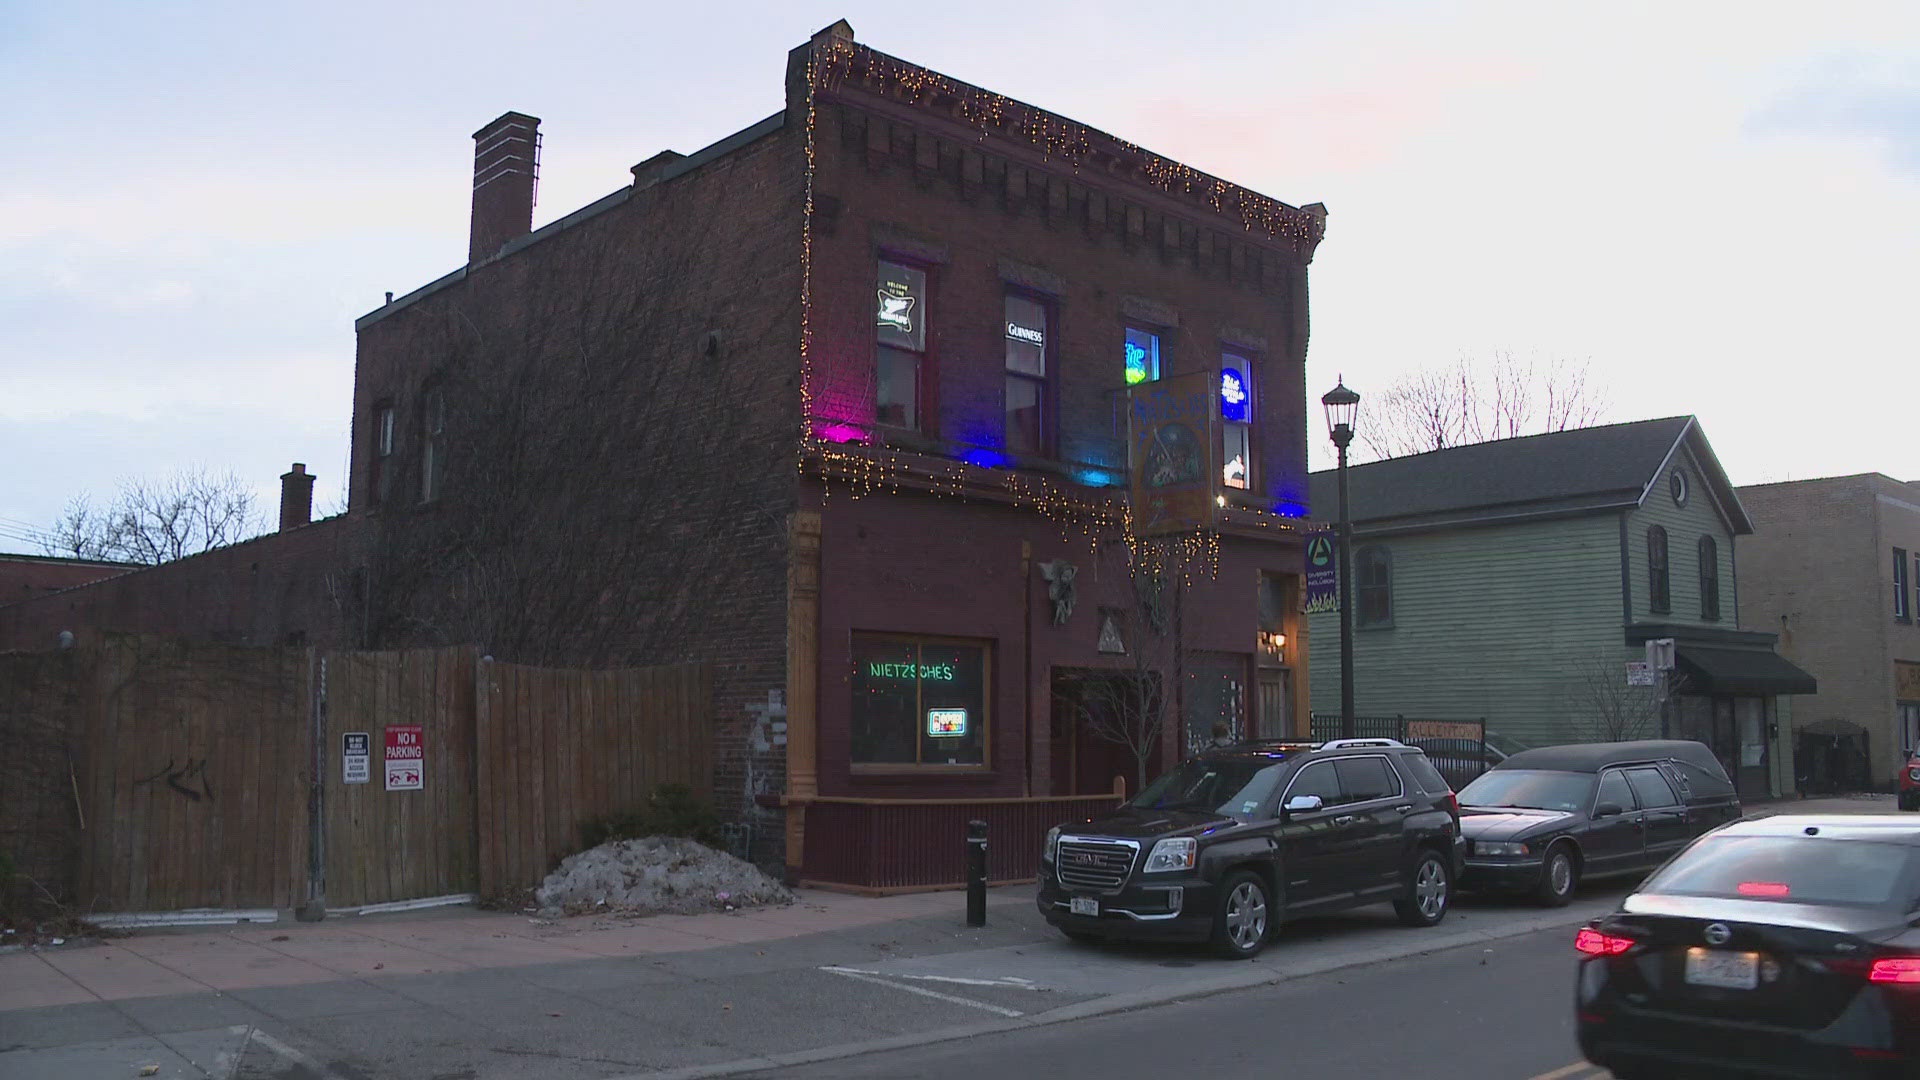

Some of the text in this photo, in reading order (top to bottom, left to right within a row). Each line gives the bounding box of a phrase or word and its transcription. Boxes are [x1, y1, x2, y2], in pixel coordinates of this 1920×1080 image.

[870, 662, 953, 681] NIETZSCHE'S
[398, 733, 410, 745] NO
[386, 745, 422, 759] PARKING
[1072, 853, 1108, 866] GMC
